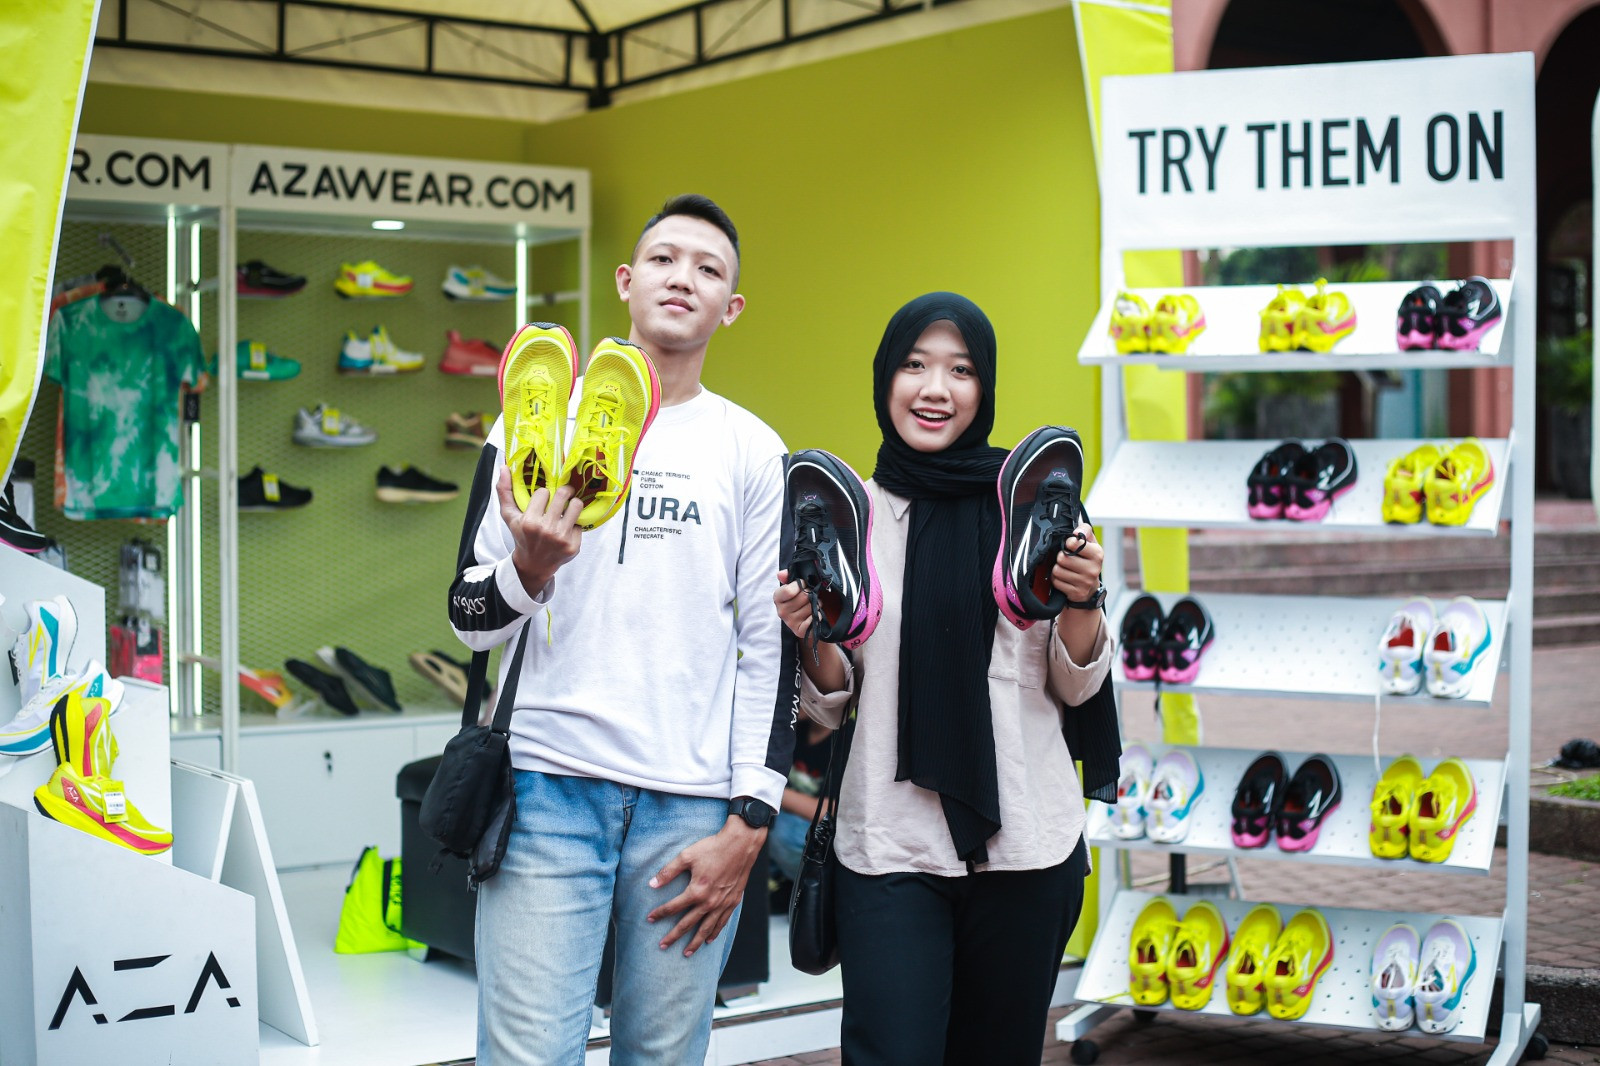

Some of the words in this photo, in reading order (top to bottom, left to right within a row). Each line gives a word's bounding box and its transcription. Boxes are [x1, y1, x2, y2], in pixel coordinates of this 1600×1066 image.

[1128, 124, 1227, 195] TRY
[1246, 115, 1400, 190] THEM
[1426, 110, 1504, 183] ON
[249, 161, 576, 214] AZAWEAR.COM
[637, 496, 702, 525] URA
[48, 950, 241, 1030] AZA
